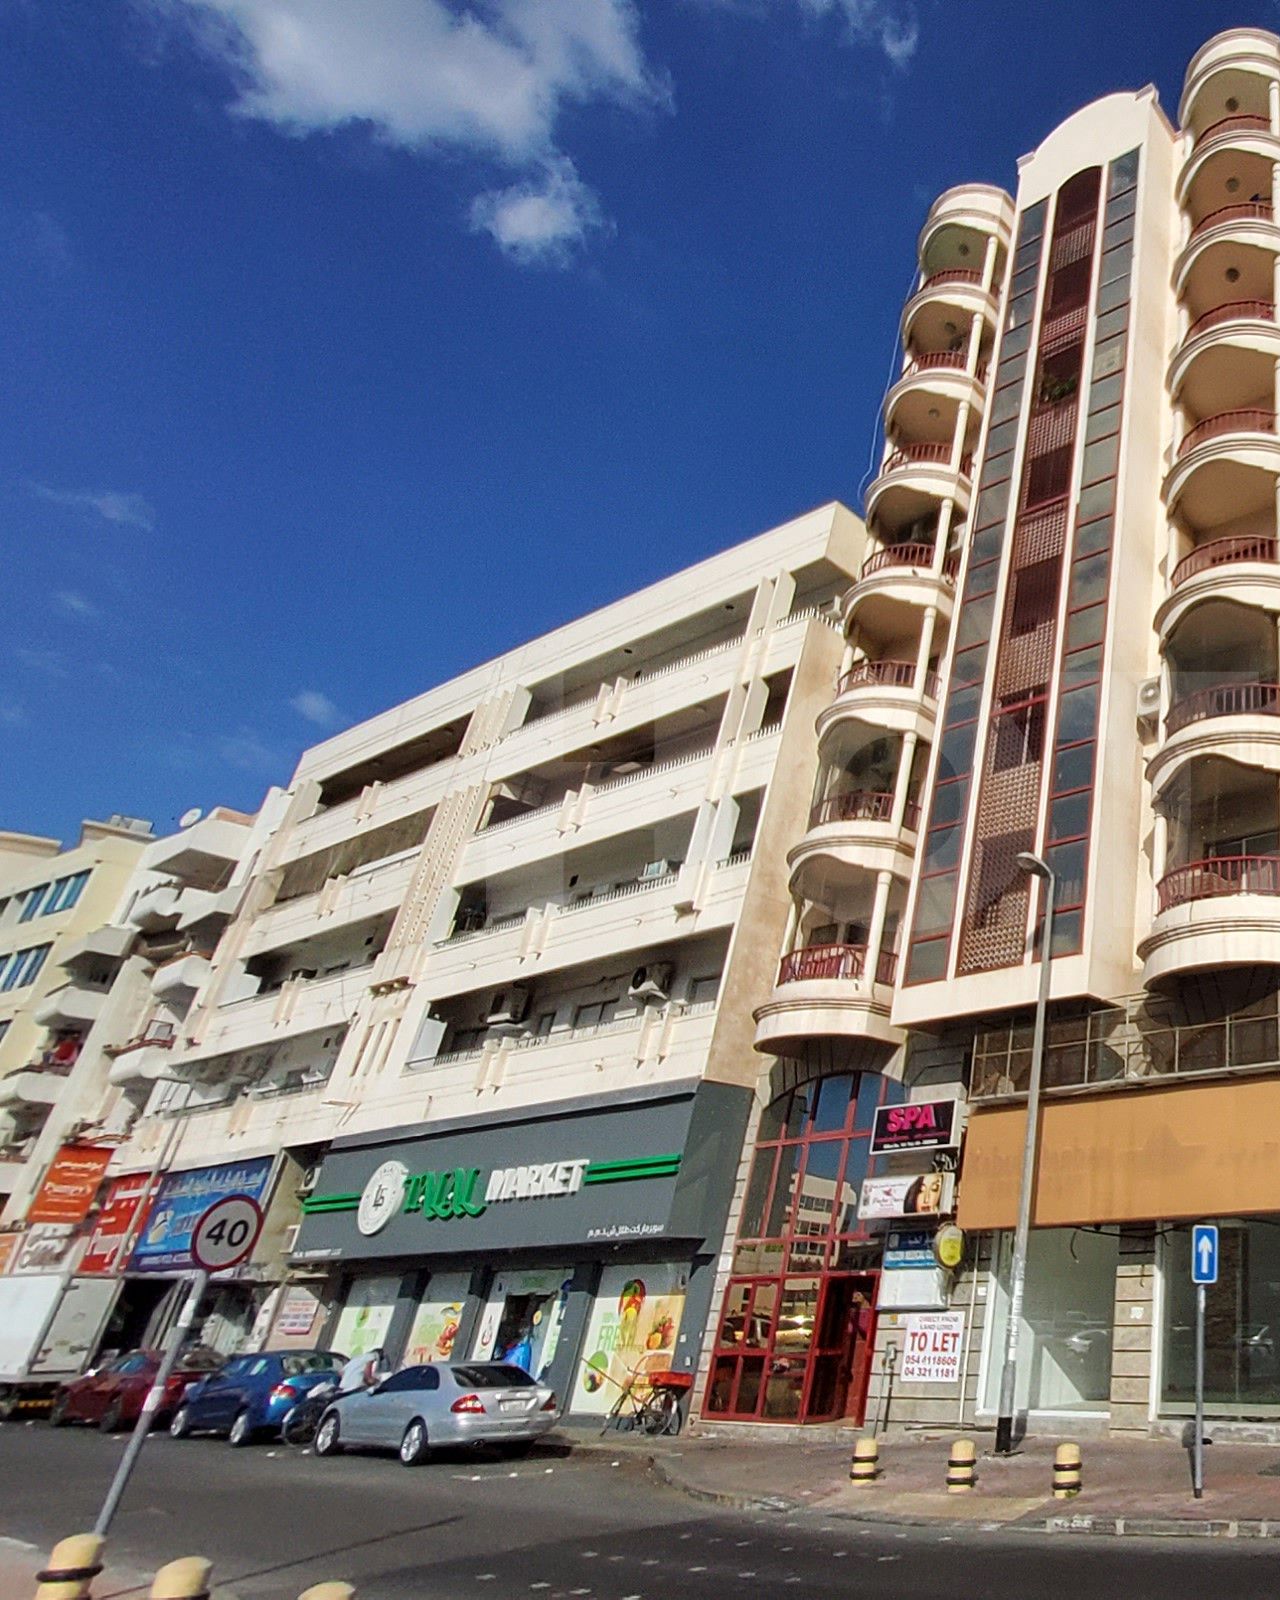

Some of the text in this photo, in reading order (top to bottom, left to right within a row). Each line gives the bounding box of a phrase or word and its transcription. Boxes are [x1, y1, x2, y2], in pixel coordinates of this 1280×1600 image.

[887, 1104, 936, 1132] SPA
[403, 1158, 590, 1219] TALAL MARKET
[205, 1218, 249, 1247] 40
[910, 1332, 960, 1352] TO LET
[905, 1355, 920, 1364] 054
[904, 1367, 955, 1377] 04 321 1181
